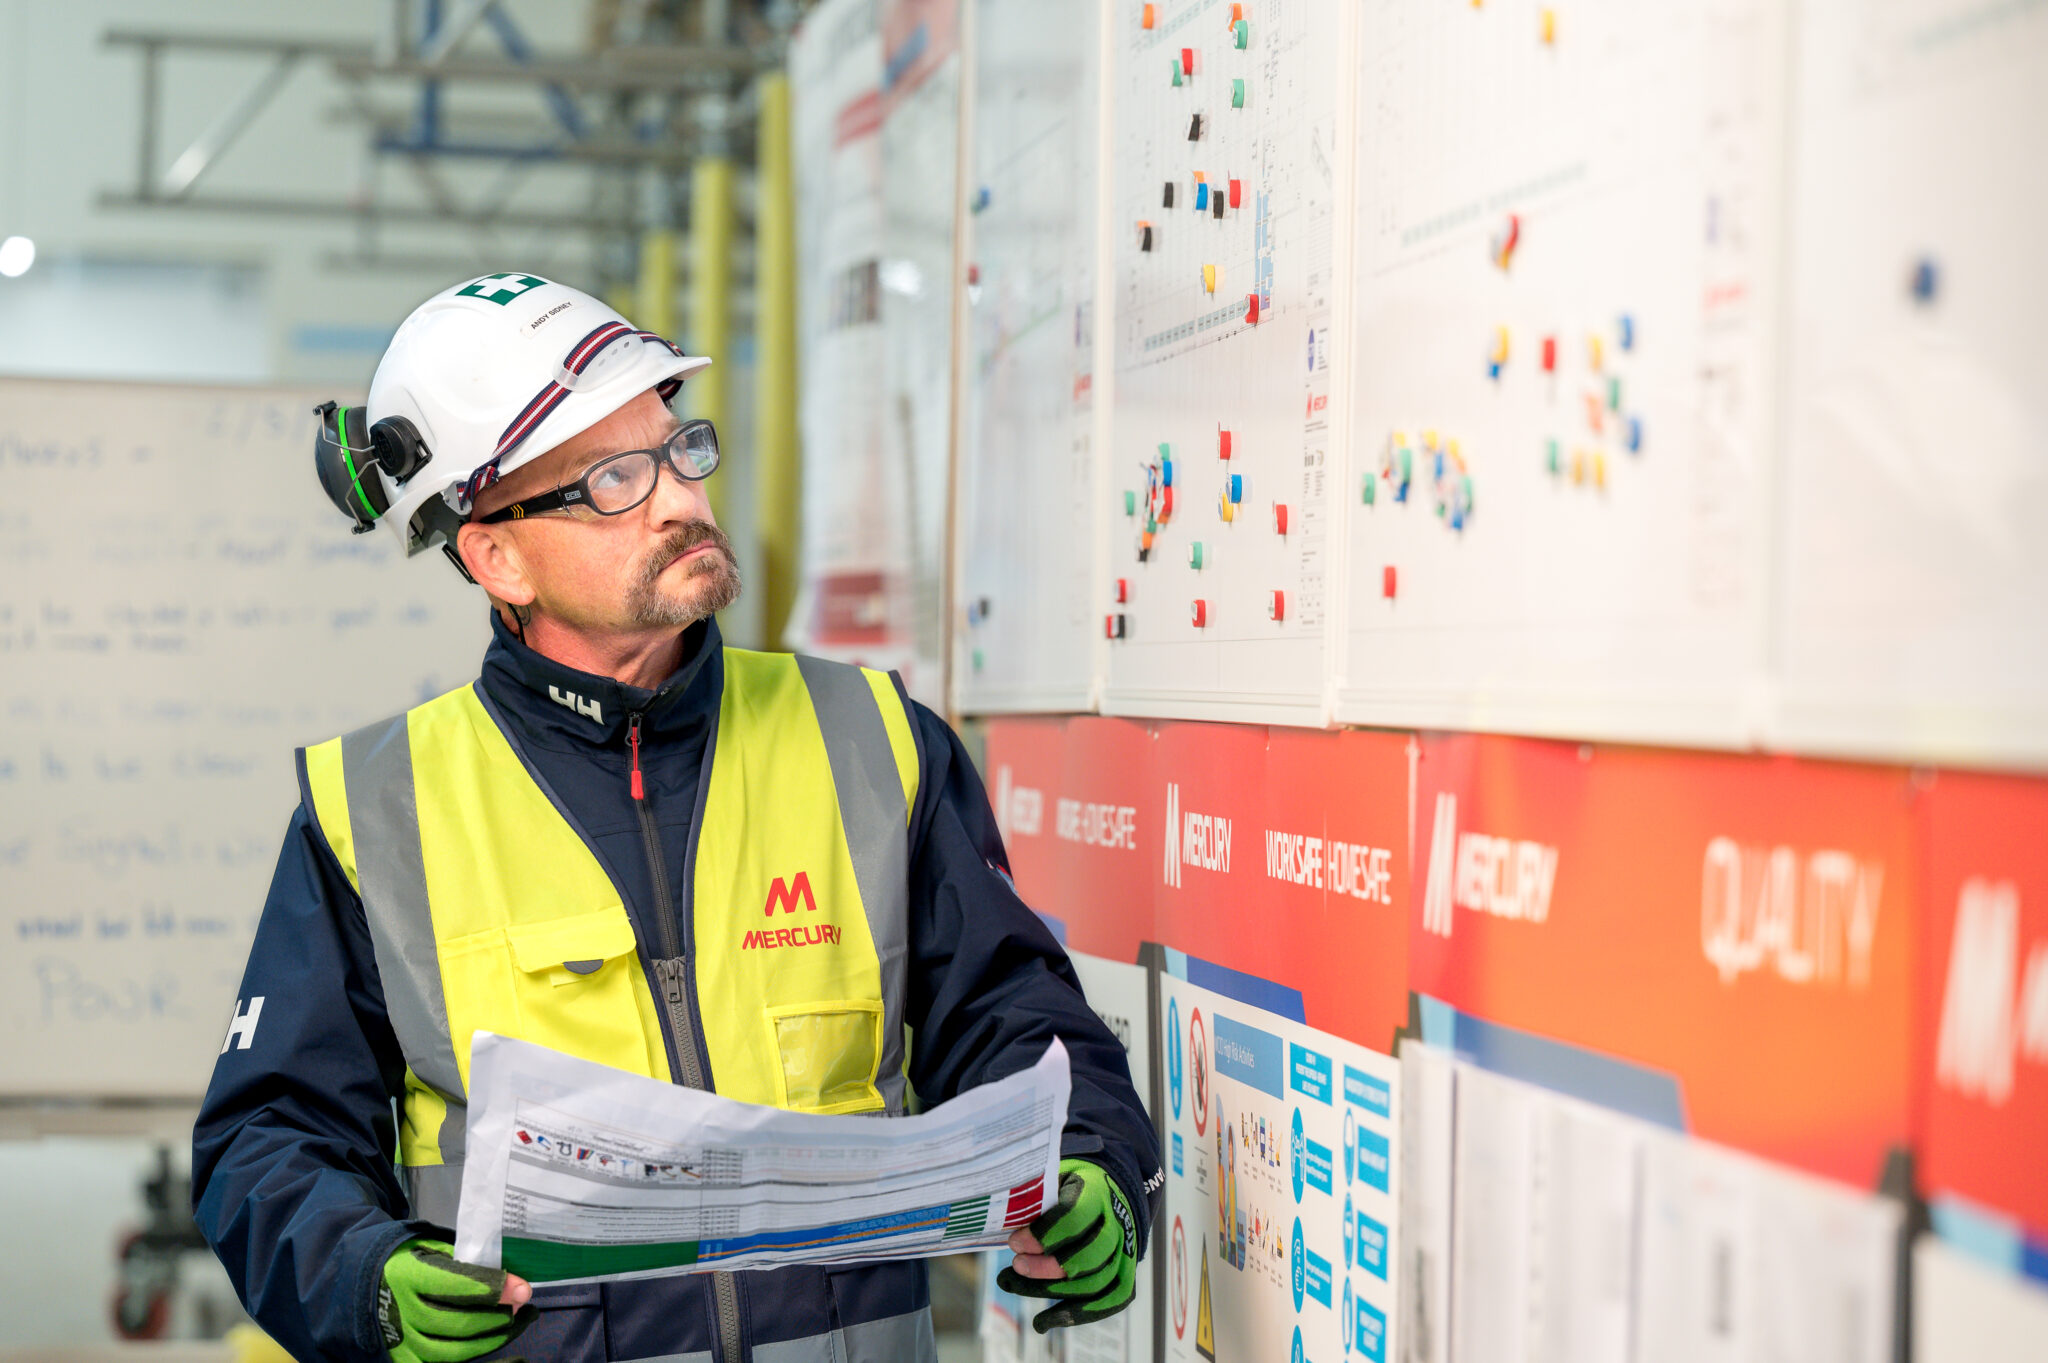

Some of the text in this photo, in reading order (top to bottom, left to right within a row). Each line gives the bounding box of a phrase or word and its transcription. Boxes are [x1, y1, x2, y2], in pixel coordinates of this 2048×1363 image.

[530, 301, 572, 330] ANDY SIDNEY
[1182, 810, 1232, 873] MERCURY
[1265, 828, 1392, 905] WORKSAFE HOMESAFE
[742, 924, 842, 951] MERCURY
[1700, 835, 1886, 995] QUALITY
